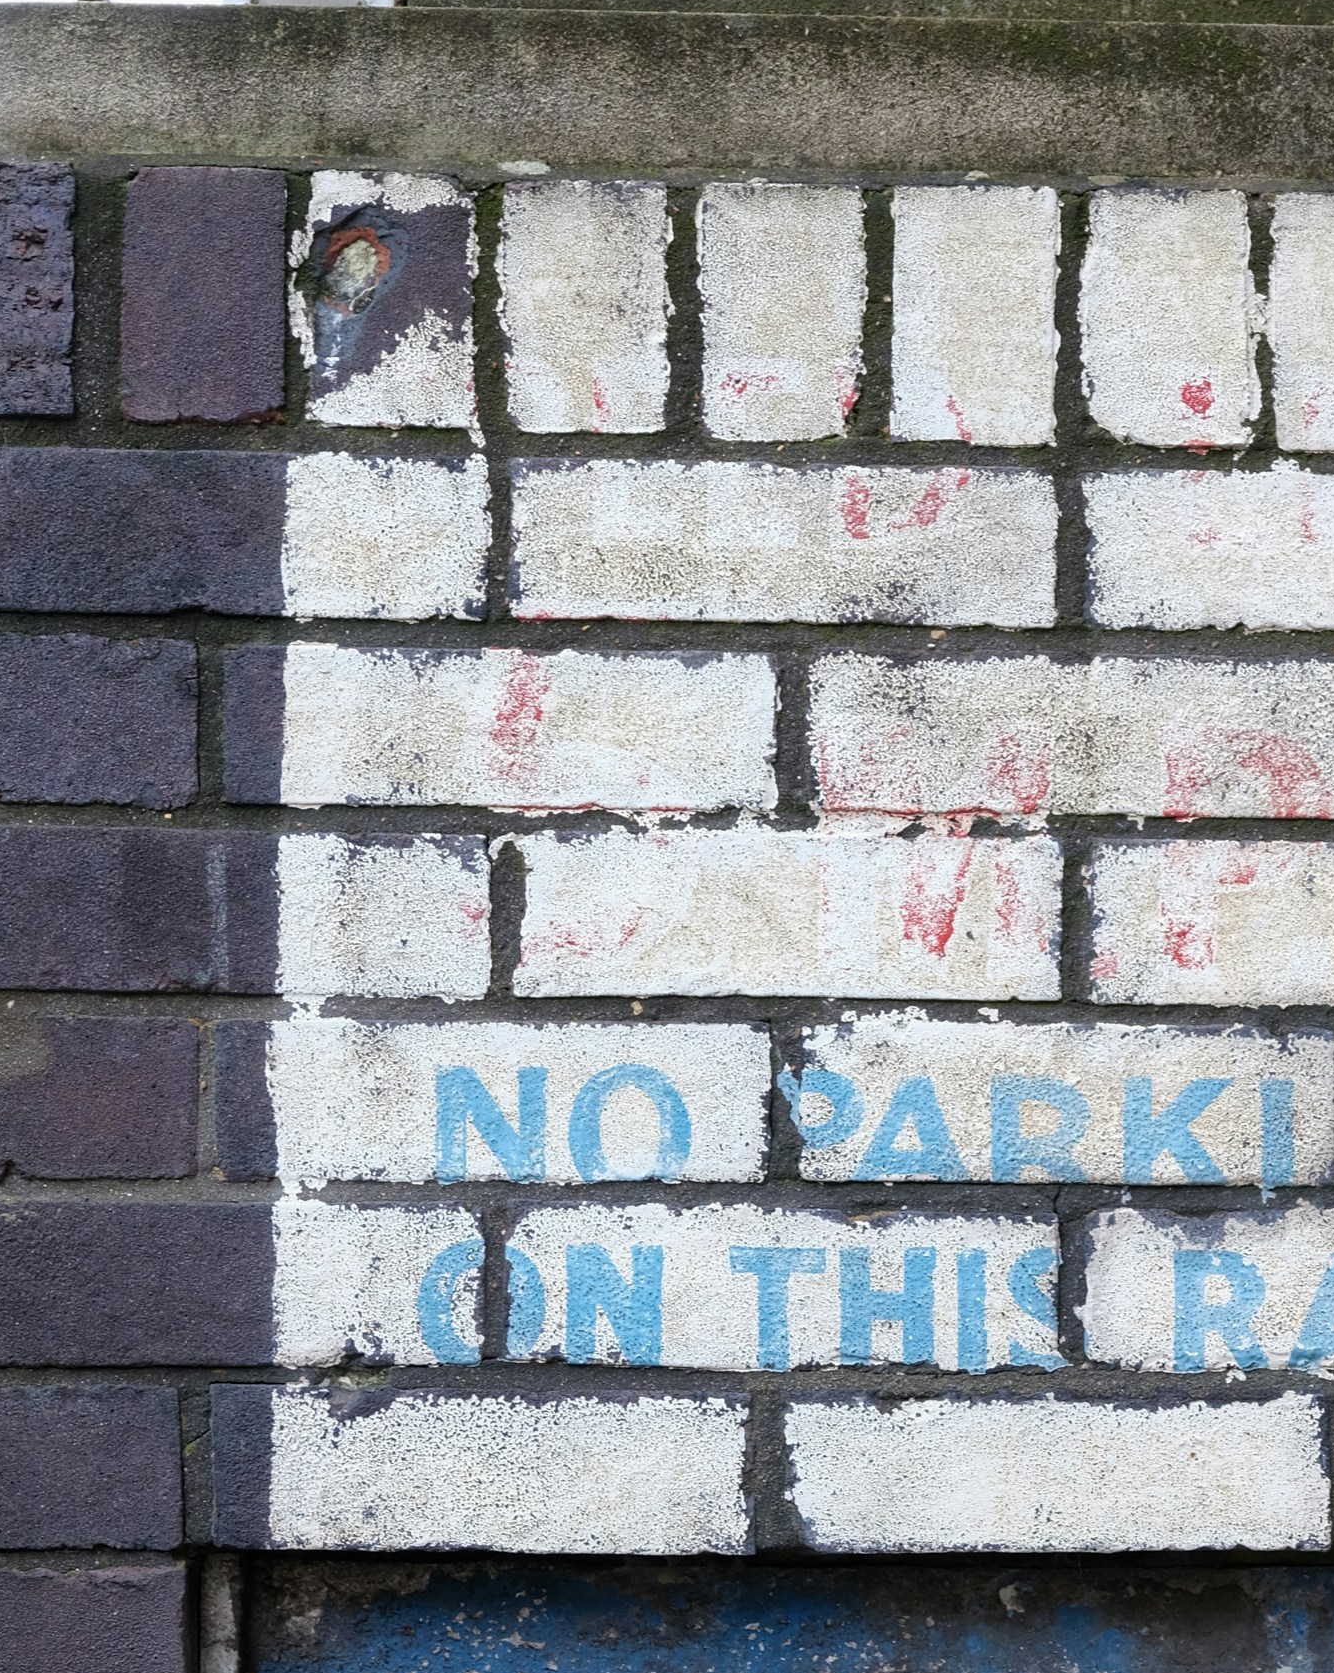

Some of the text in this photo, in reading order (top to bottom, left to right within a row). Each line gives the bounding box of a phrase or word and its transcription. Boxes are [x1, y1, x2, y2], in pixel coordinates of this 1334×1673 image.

[434, 1063, 692, 1184] NO
[415, 1237, 664, 1367] ON
[728, 1244, 1068, 1373] THIS
